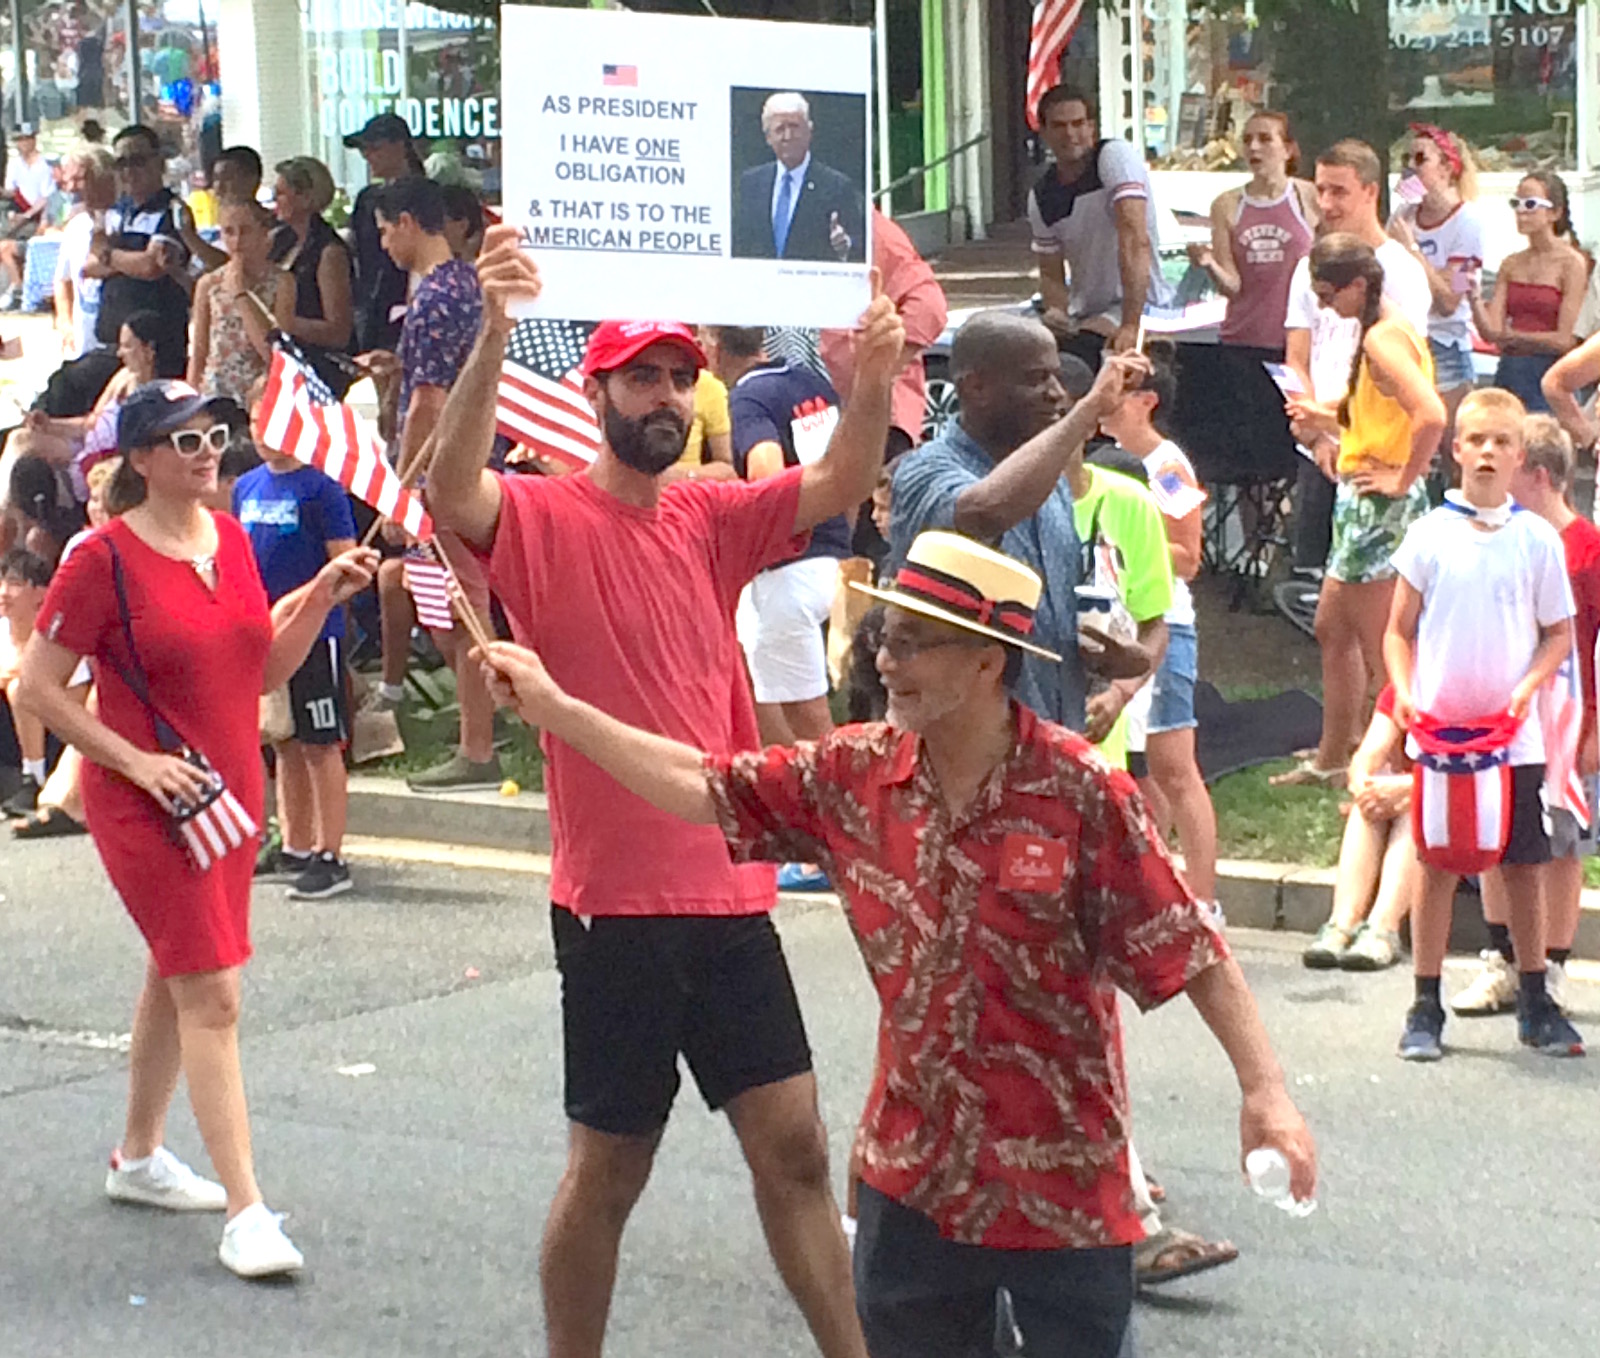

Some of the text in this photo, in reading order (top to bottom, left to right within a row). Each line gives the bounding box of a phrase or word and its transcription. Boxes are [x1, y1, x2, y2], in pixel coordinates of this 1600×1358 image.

[1445, 29, 1492, 48] 244
[1500, 26, 1565, 48] 5107
[321, 49, 402, 94] BUILD
[542, 95, 698, 120] AS PRESIDENT
[560, 134, 681, 158] I HAVE ONE
[555, 161, 686, 185] OBLIGATION
[528, 199, 711, 224] & THAT IS TO THE
[518, 225, 721, 251] AMERICAN PEOPLE
[305, 697, 336, 729] 10
